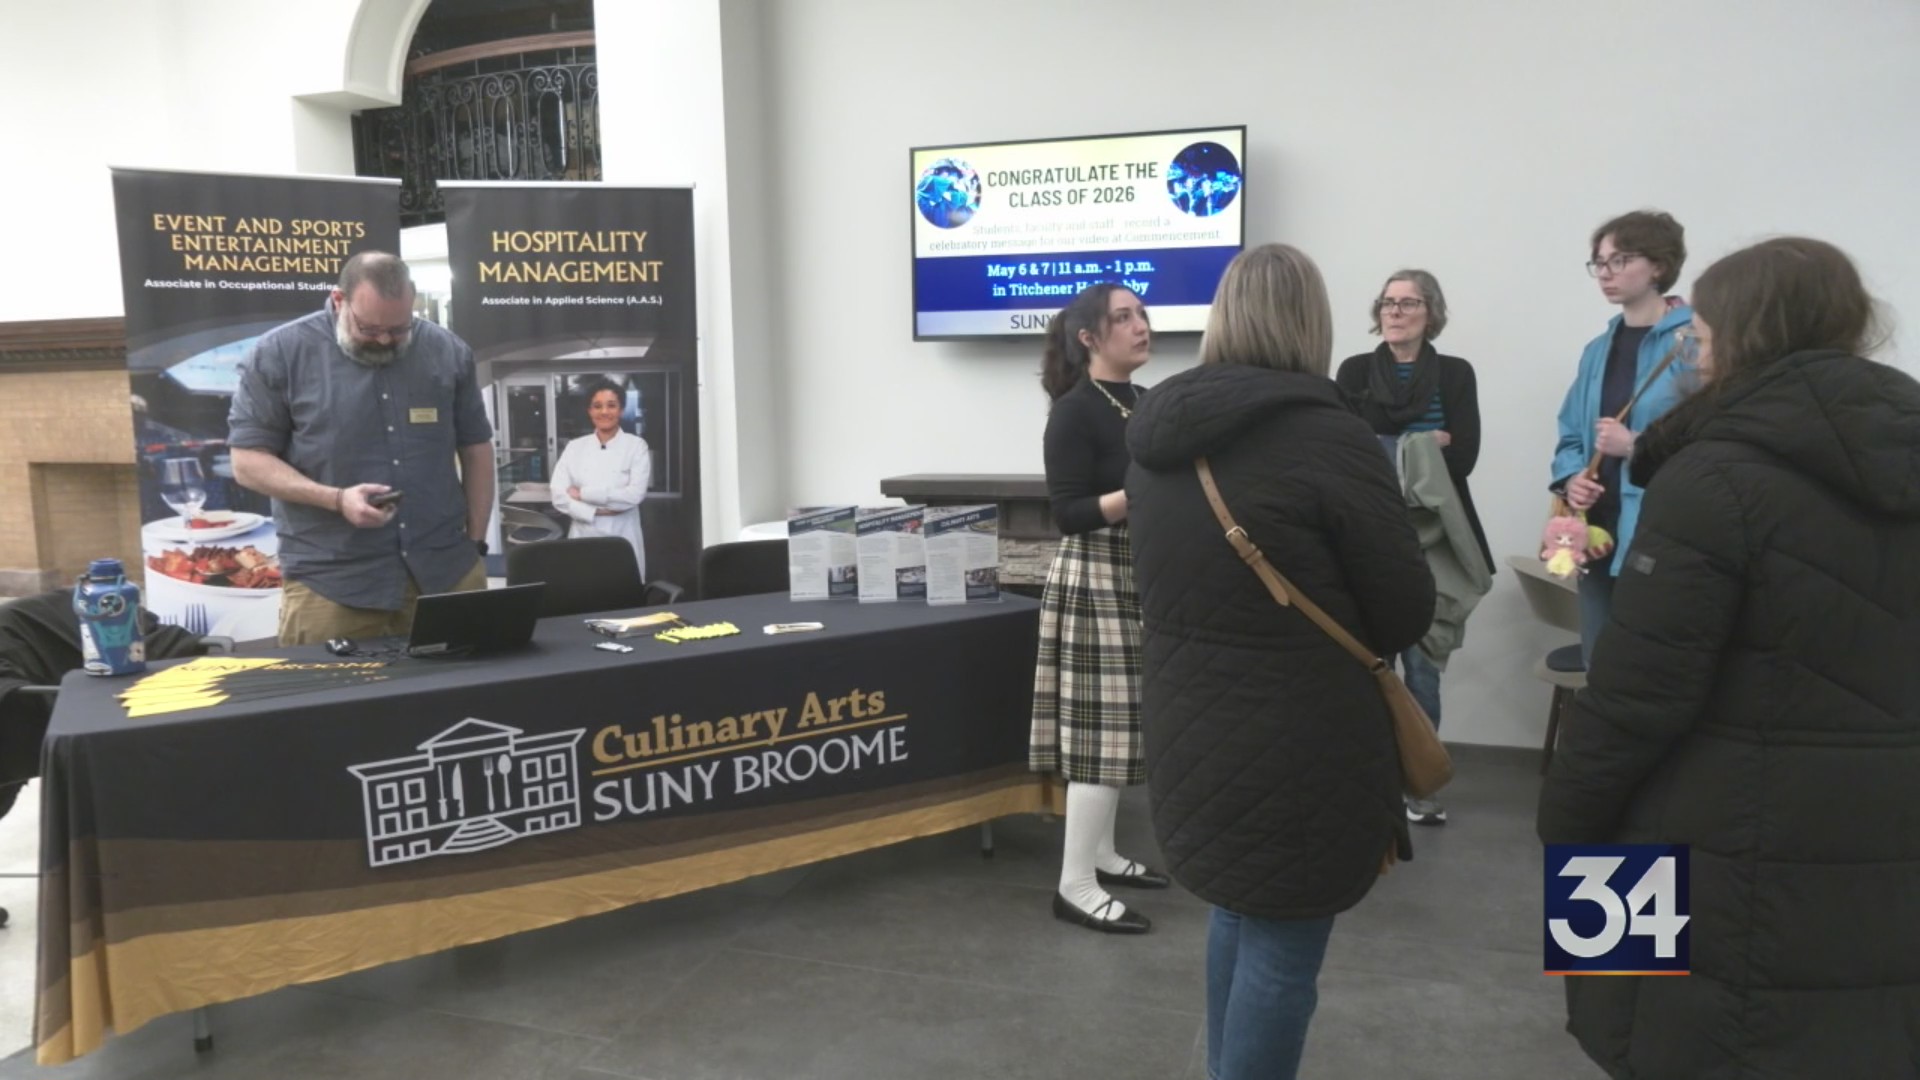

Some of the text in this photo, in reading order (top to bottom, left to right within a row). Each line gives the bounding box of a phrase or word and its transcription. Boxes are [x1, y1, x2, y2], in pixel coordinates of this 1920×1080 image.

[987, 161, 1159, 187] CONGRATULATE THE
[1009, 185, 1136, 208] CLASS OF 2026
[153, 213, 366, 239] EVENT AND SPORTS
[1163, 217, 1171, 226] a
[171, 233, 352, 256] ENTERTAINMENT
[492, 231, 648, 253] HOSPITALITY
[929, 239, 989, 252] celebratory
[990, 237, 1037, 250] message
[1079, 234, 1110, 245] video
[1111, 233, 1123, 244] at
[184, 253, 343, 274] MANAGEMENT
[478, 260, 664, 283] MANAGEMENT
[987, 264, 1017, 279] May
[1018, 263, 1027, 275] 6
[1029, 262, 1040, 275] &
[1041, 262, 1050, 275] 7
[1058, 261, 1072, 275] 11
[1074, 262, 1104, 274] a.m.
[1115, 260, 1122, 273] 1
[1124, 261, 1156, 275] p.m.
[144, 278, 202, 289] Associate
[204, 279, 216, 289] in
[218, 279, 296, 292] Occupational
[992, 283, 1007, 296] in
[1008, 282, 1074, 297] Titchener
[482, 295, 663, 307] Associate in Applied Science (A.A.S.)
[591, 687, 887, 764] Culinary Arts
[592, 726, 909, 821] SUNY BROOME
